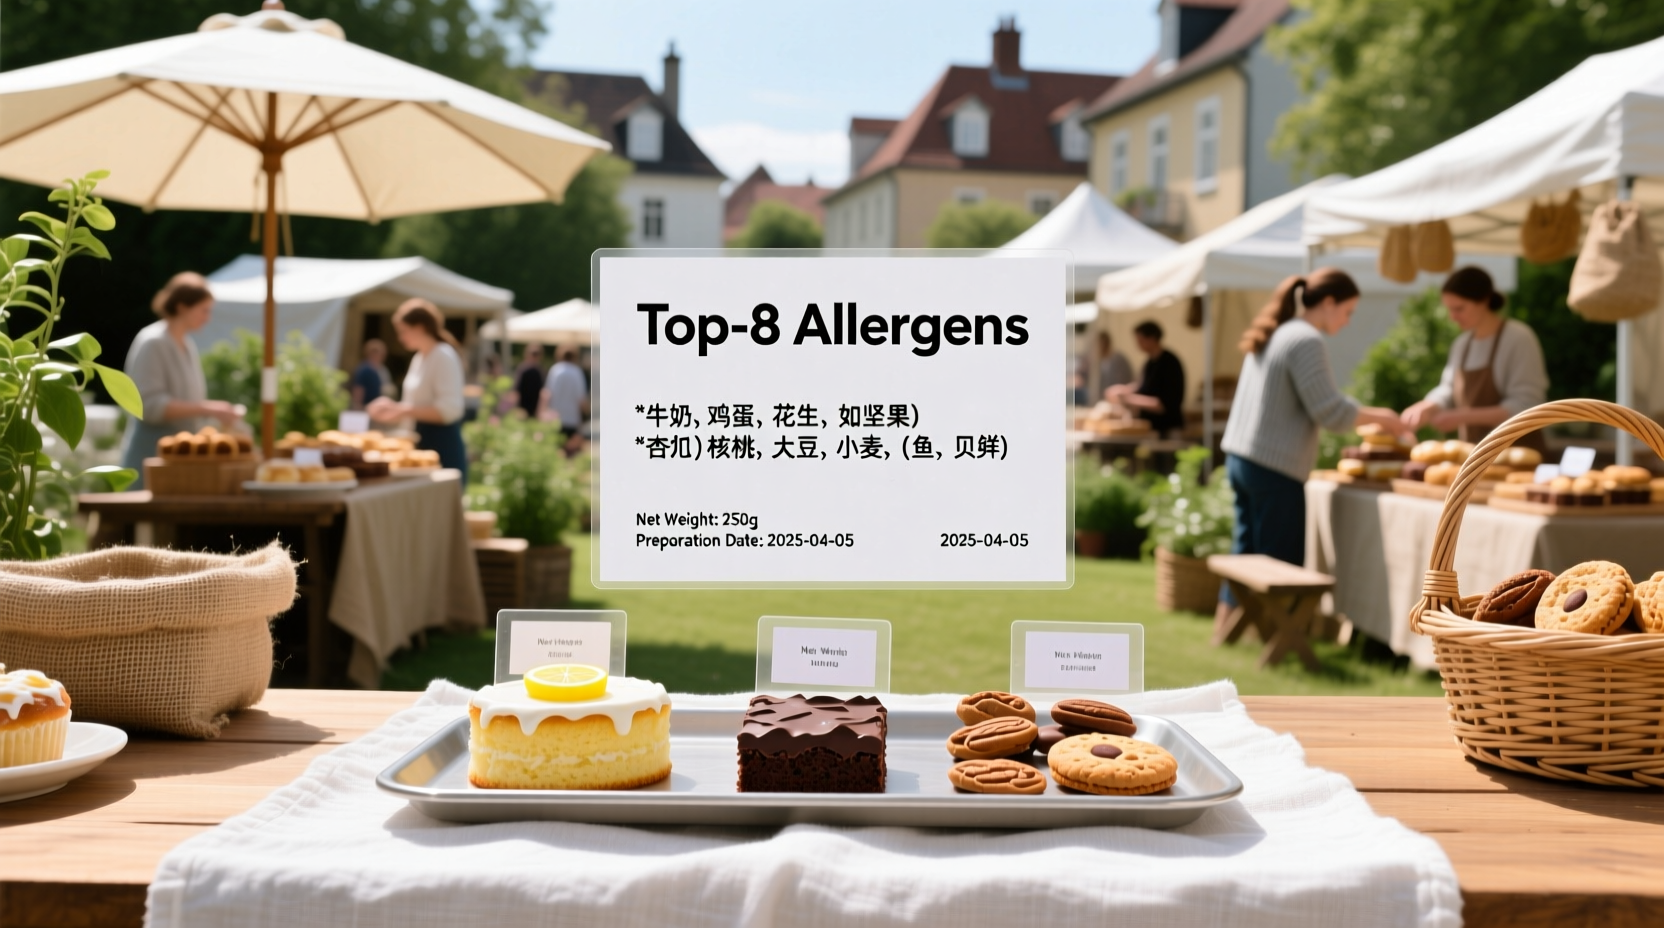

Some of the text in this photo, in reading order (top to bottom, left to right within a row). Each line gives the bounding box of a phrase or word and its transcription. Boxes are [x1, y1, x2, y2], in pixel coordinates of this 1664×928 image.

[636, 301, 1030, 358] Top-8 Allergens
[636, 511, 759, 531] Net Weight: 250g
[725, 533, 764, 548] Date:
[767, 533, 855, 548] 2025-04-05
[940, 532, 1029, 548] 2025-04-05
